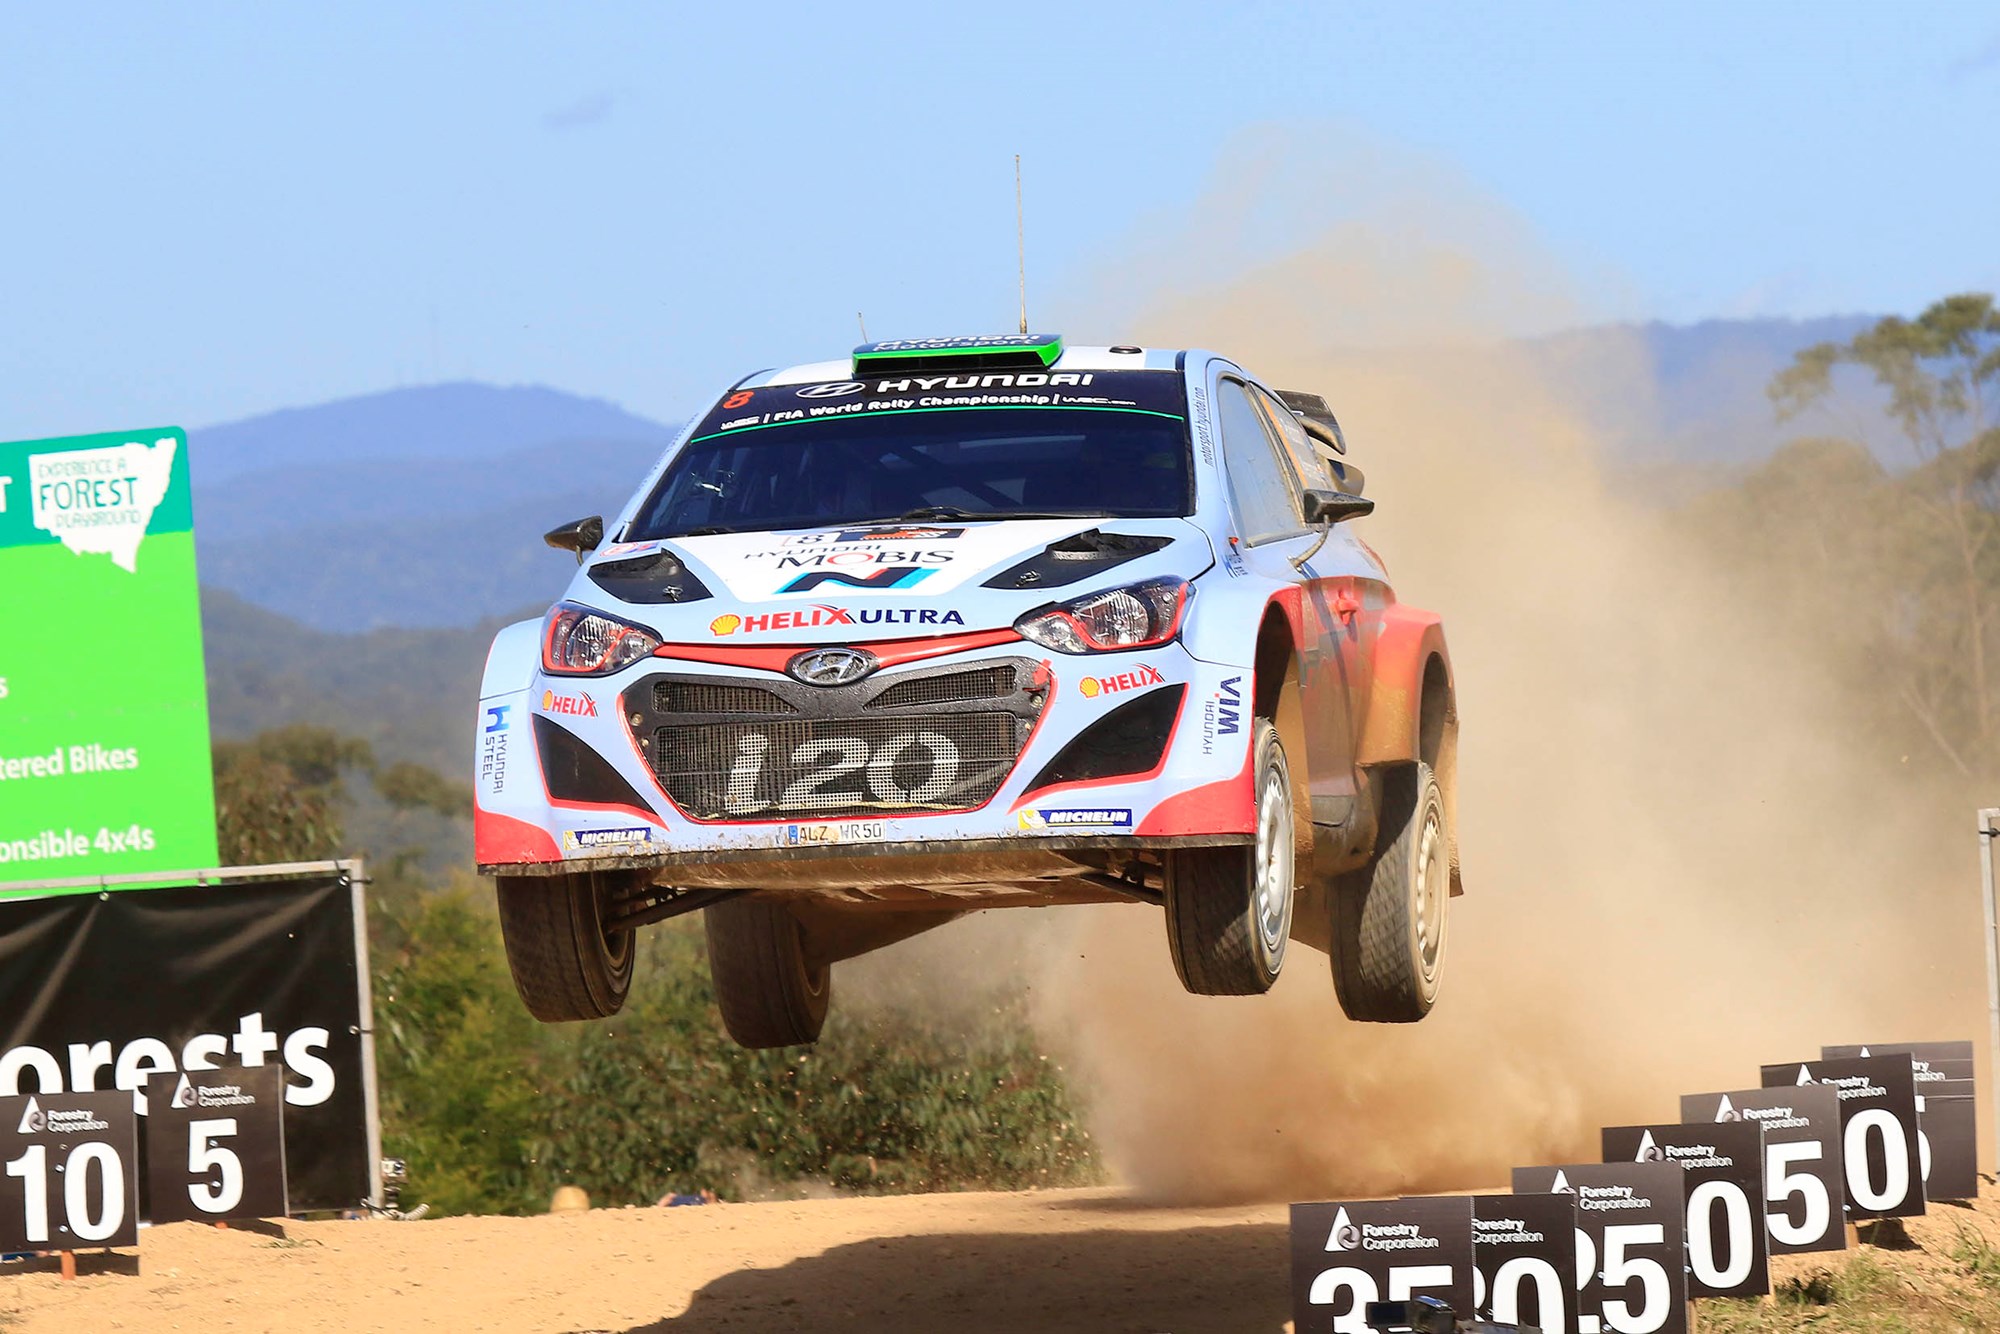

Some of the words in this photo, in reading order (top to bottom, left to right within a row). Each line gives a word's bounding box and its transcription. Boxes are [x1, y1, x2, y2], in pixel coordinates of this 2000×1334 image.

[876, 373, 1095, 393] HYUNDAI
[722, 391, 754, 409] 8
[773, 410, 805, 422] FIA
[809, 402, 863, 417] World
[867, 397, 915, 411] Rally
[919, 394, 1050, 407] Championship
[39, 477, 138, 511] FOREST
[743, 544, 883, 559] HYUNDAI
[776, 549, 955, 569] MOBIS
[744, 604, 857, 633] HELIX
[860, 608, 966, 626] ULTRA
[1100, 664, 1166, 695] HELIX
[552, 690, 599, 718] HELIX
[1202, 700, 1216, 755] HYUNDAI
[68, 743, 139, 774] Bikes
[482, 736, 495, 781] STEEL
[492, 734, 508, 794] HYUNDAI
[1048, 811, 1128, 823] MICHELIN
[93, 824, 157, 853] 4x4s
[580, 830, 647, 844] MICHELIN
[799, 825, 829, 841] ALZ
[197, 1085, 242, 1097] Forestry
[197, 1095, 257, 1109] Corporation
[47, 1109, 94, 1122] Forestry
[1742, 1106, 1793, 1120] Forestry
[47, 1120, 110, 1133] Corporation
[1664, 1144, 1716, 1158] Forestry
[187, 1118, 244, 1214] 5
[6, 1141, 125, 1242] 10
[1579, 1185, 1633, 1199] Forestry
[1579, 1196, 1652, 1212] Corporation
[1362, 1222, 1420, 1238] Forestry
[1362, 1235, 1440, 1252] Corporation
